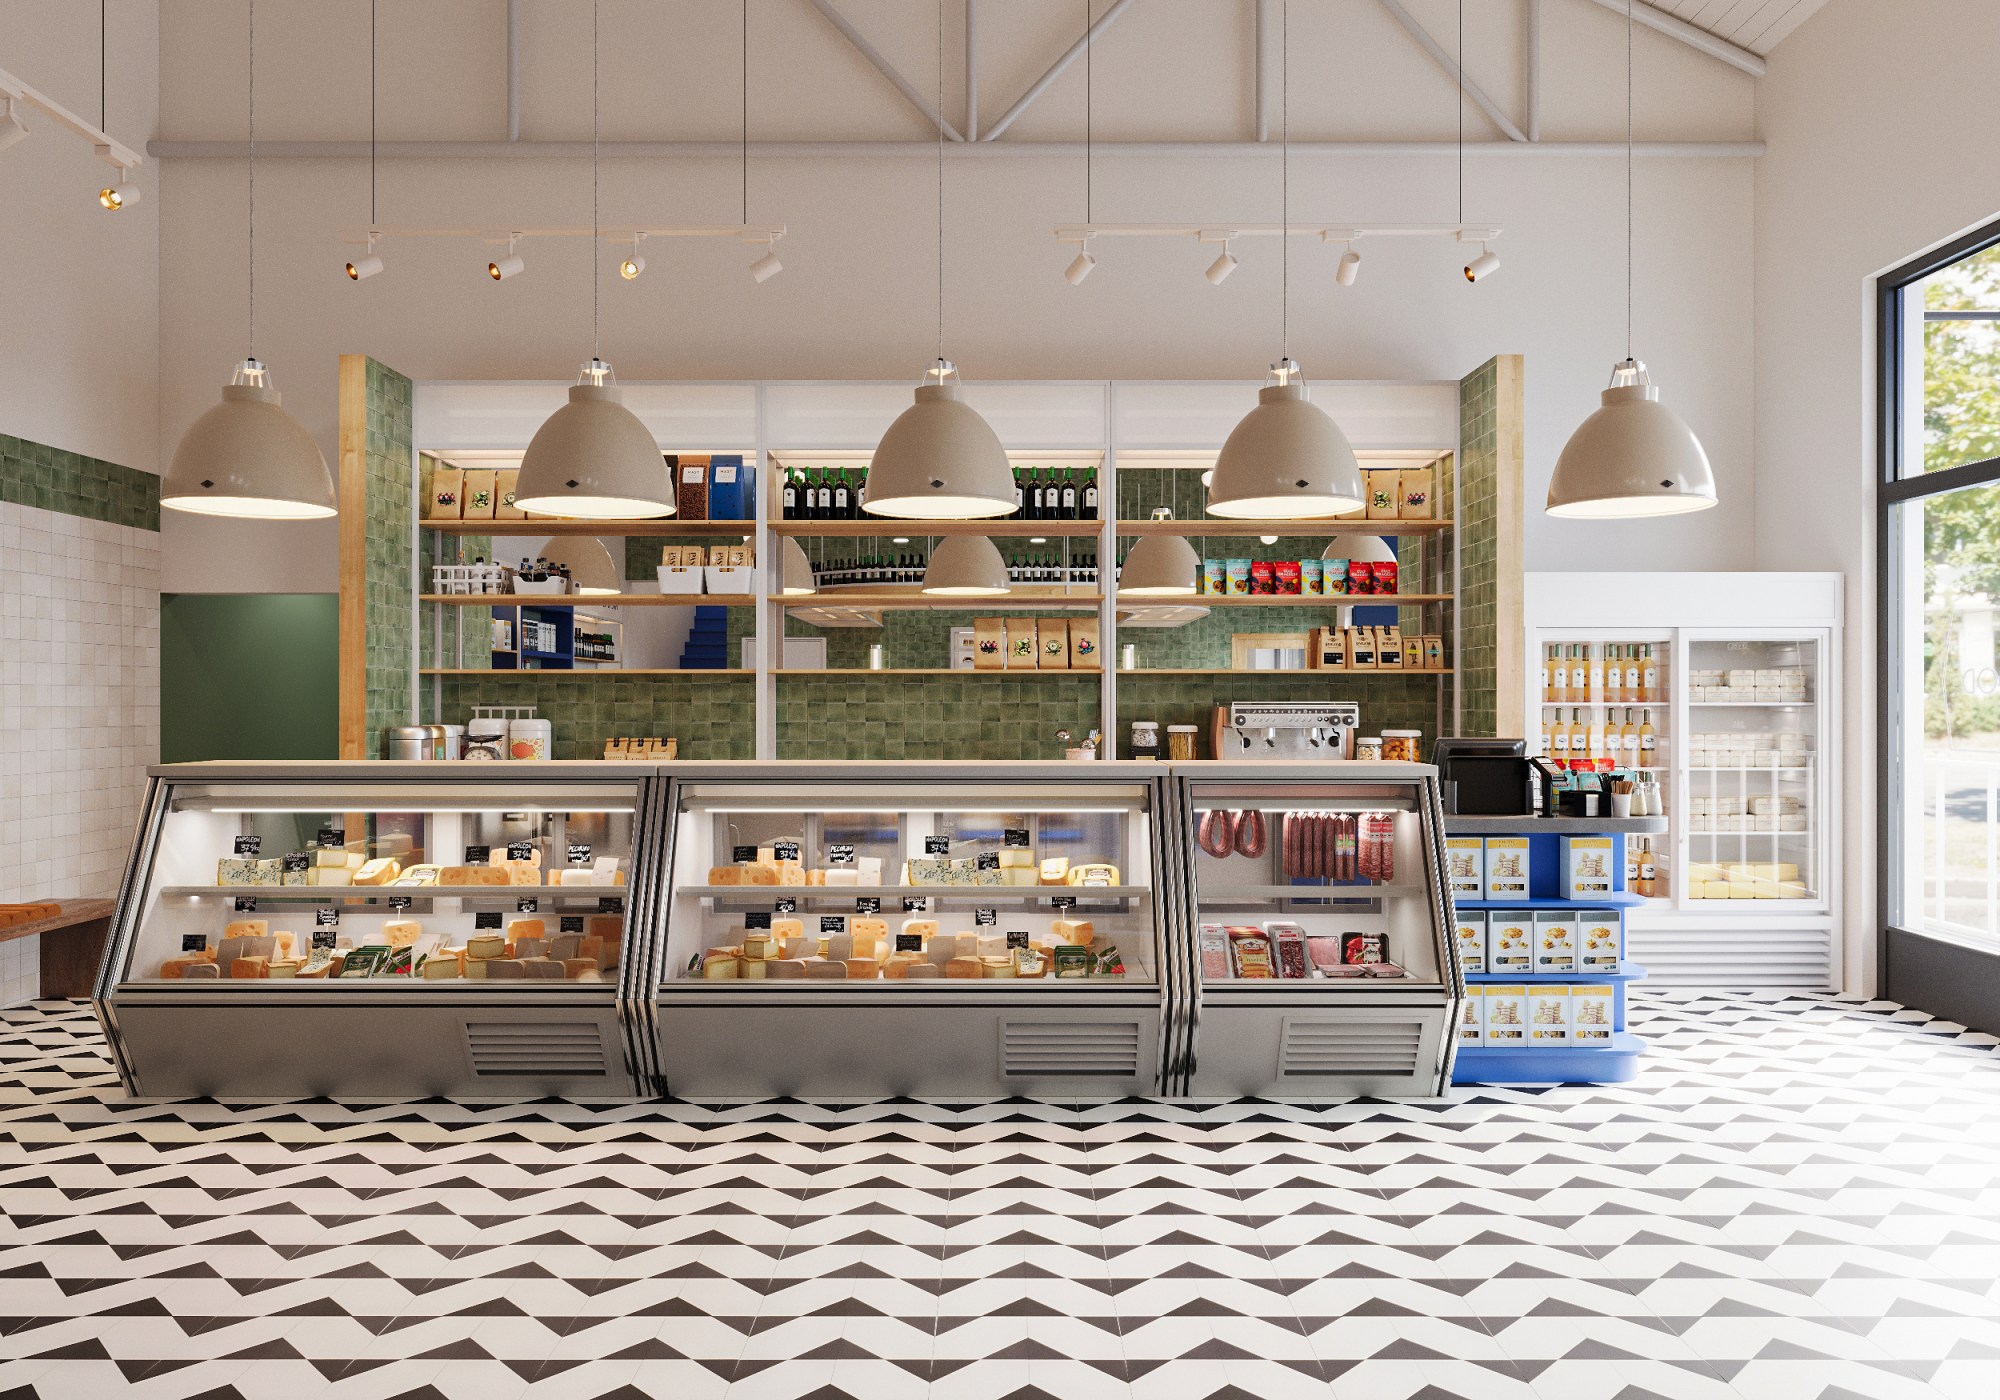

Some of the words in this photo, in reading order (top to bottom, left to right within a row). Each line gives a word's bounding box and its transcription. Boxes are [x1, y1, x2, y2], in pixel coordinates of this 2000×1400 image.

[668, 552, 677, 566] PAS
[688, 552, 697, 566] PAS
[716, 552, 724, 566] PAS
[736, 552, 744, 566] PAS
